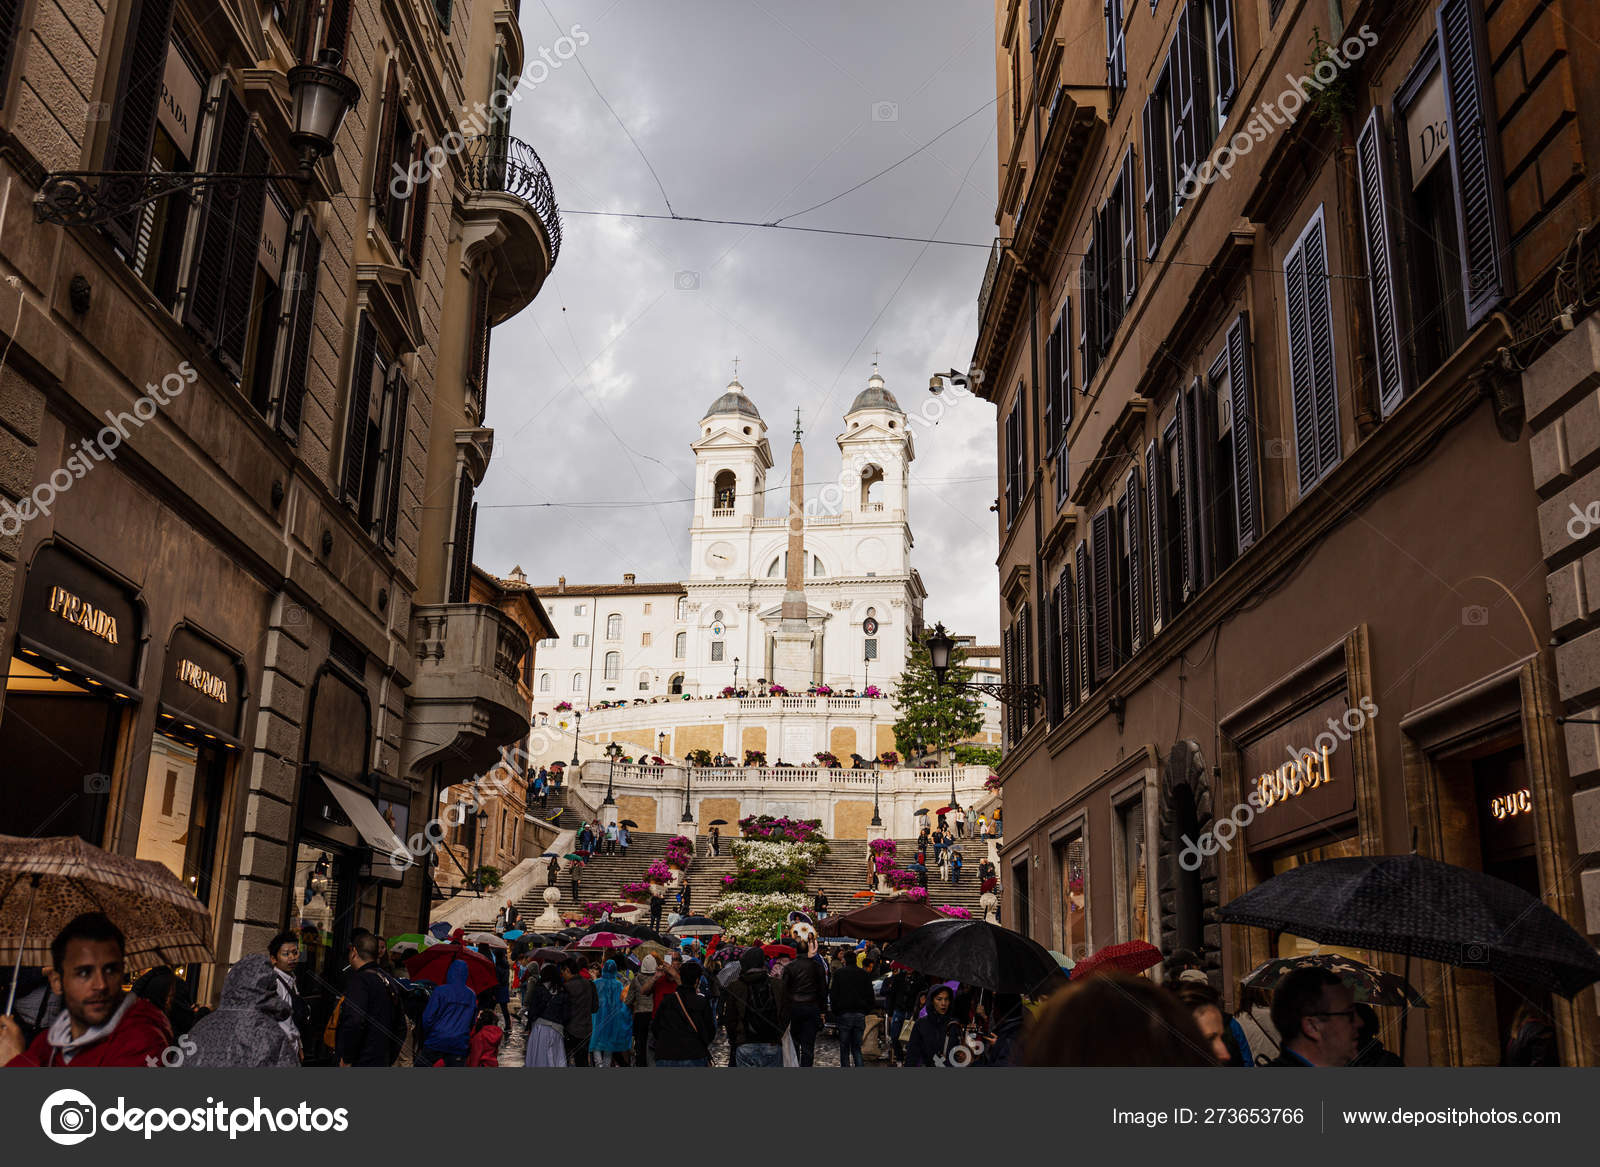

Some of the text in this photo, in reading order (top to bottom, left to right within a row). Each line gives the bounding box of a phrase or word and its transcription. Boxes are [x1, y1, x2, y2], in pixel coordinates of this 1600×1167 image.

[49, 585, 119, 645] PRADA
[177, 658, 228, 704] PRADA
[1257, 745, 1332, 808] GUCCI
